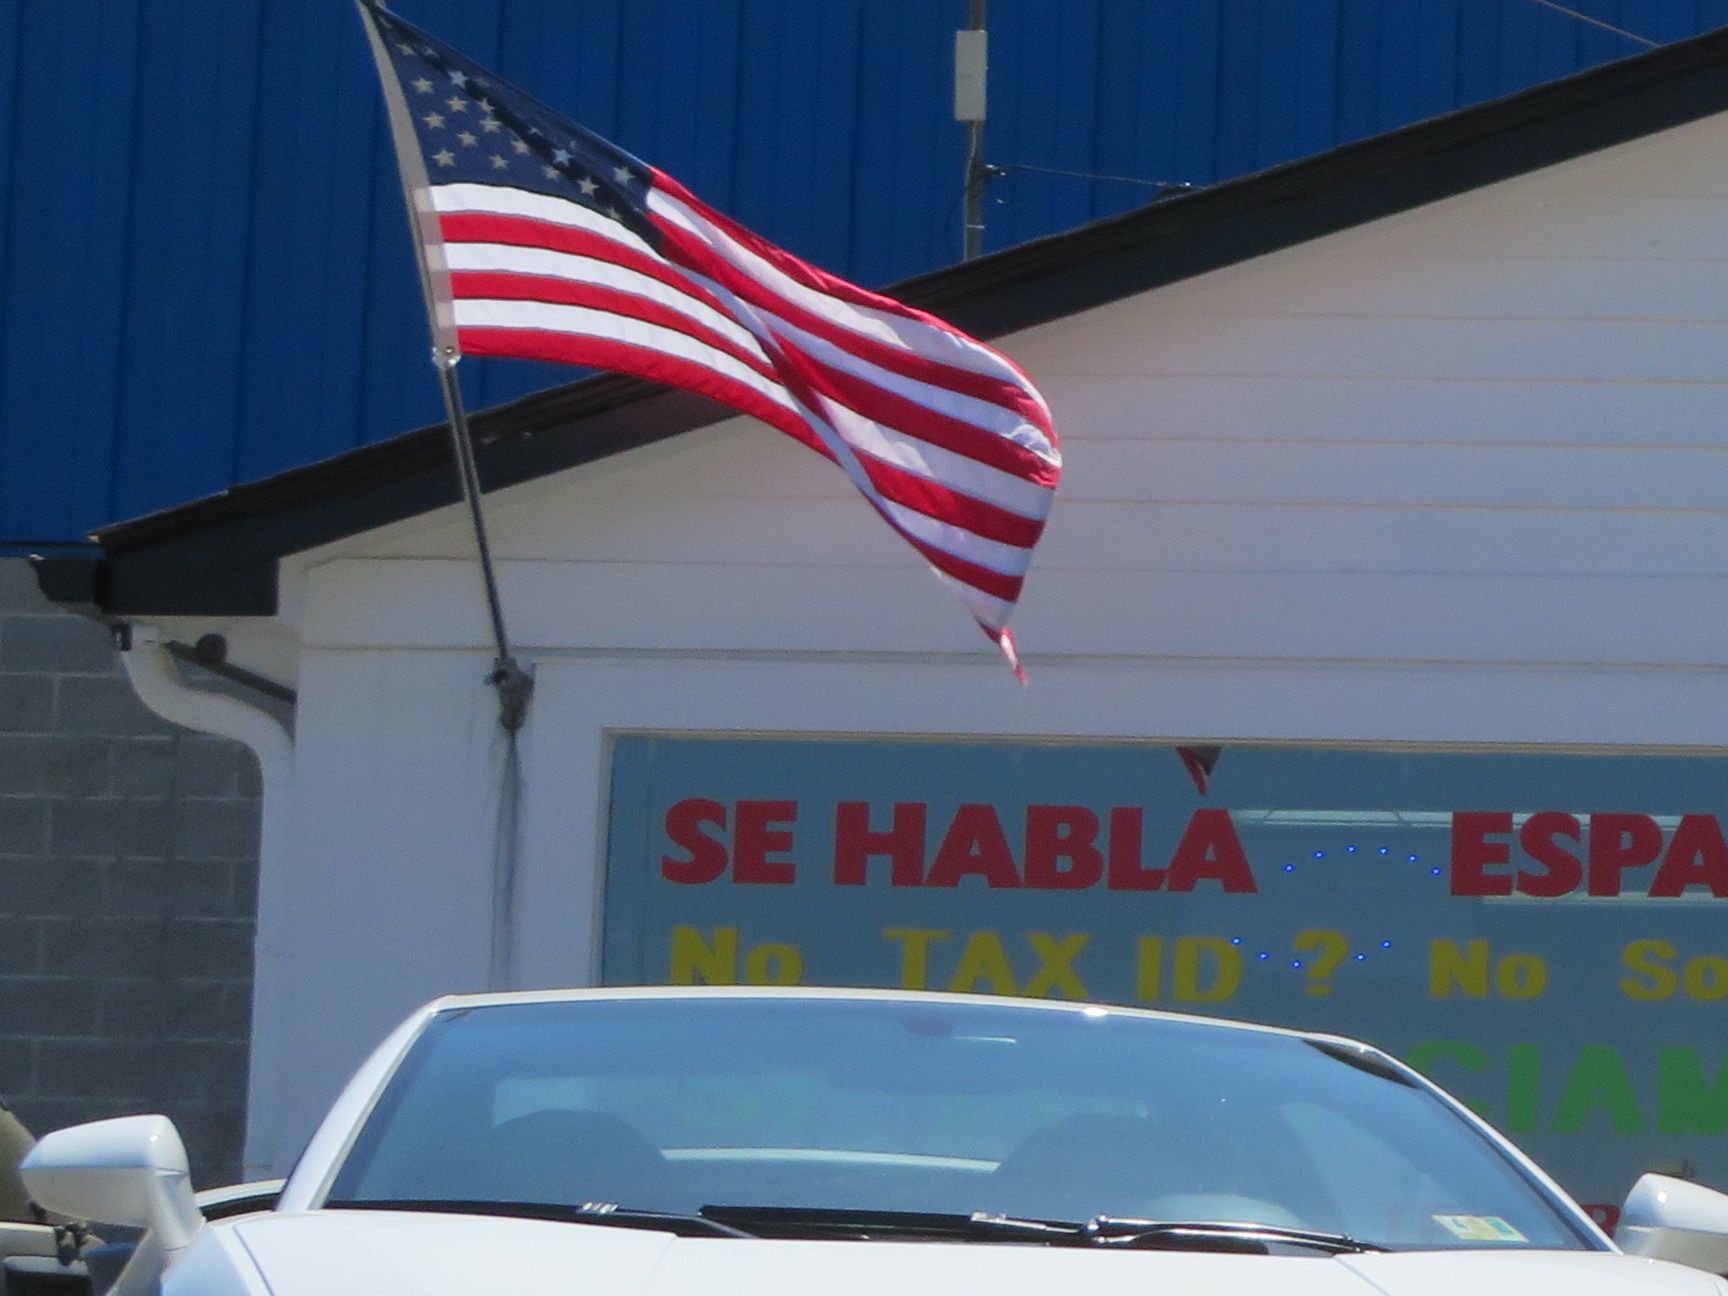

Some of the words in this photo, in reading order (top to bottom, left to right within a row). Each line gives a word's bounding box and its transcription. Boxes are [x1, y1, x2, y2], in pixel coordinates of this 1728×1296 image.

[660, 798, 798, 886] SE
[671, 927, 803, 985] No
[882, 929, 1092, 1002] TAX
[1136, 936, 1243, 1003] ID
[1429, 939, 1549, 1000] No
